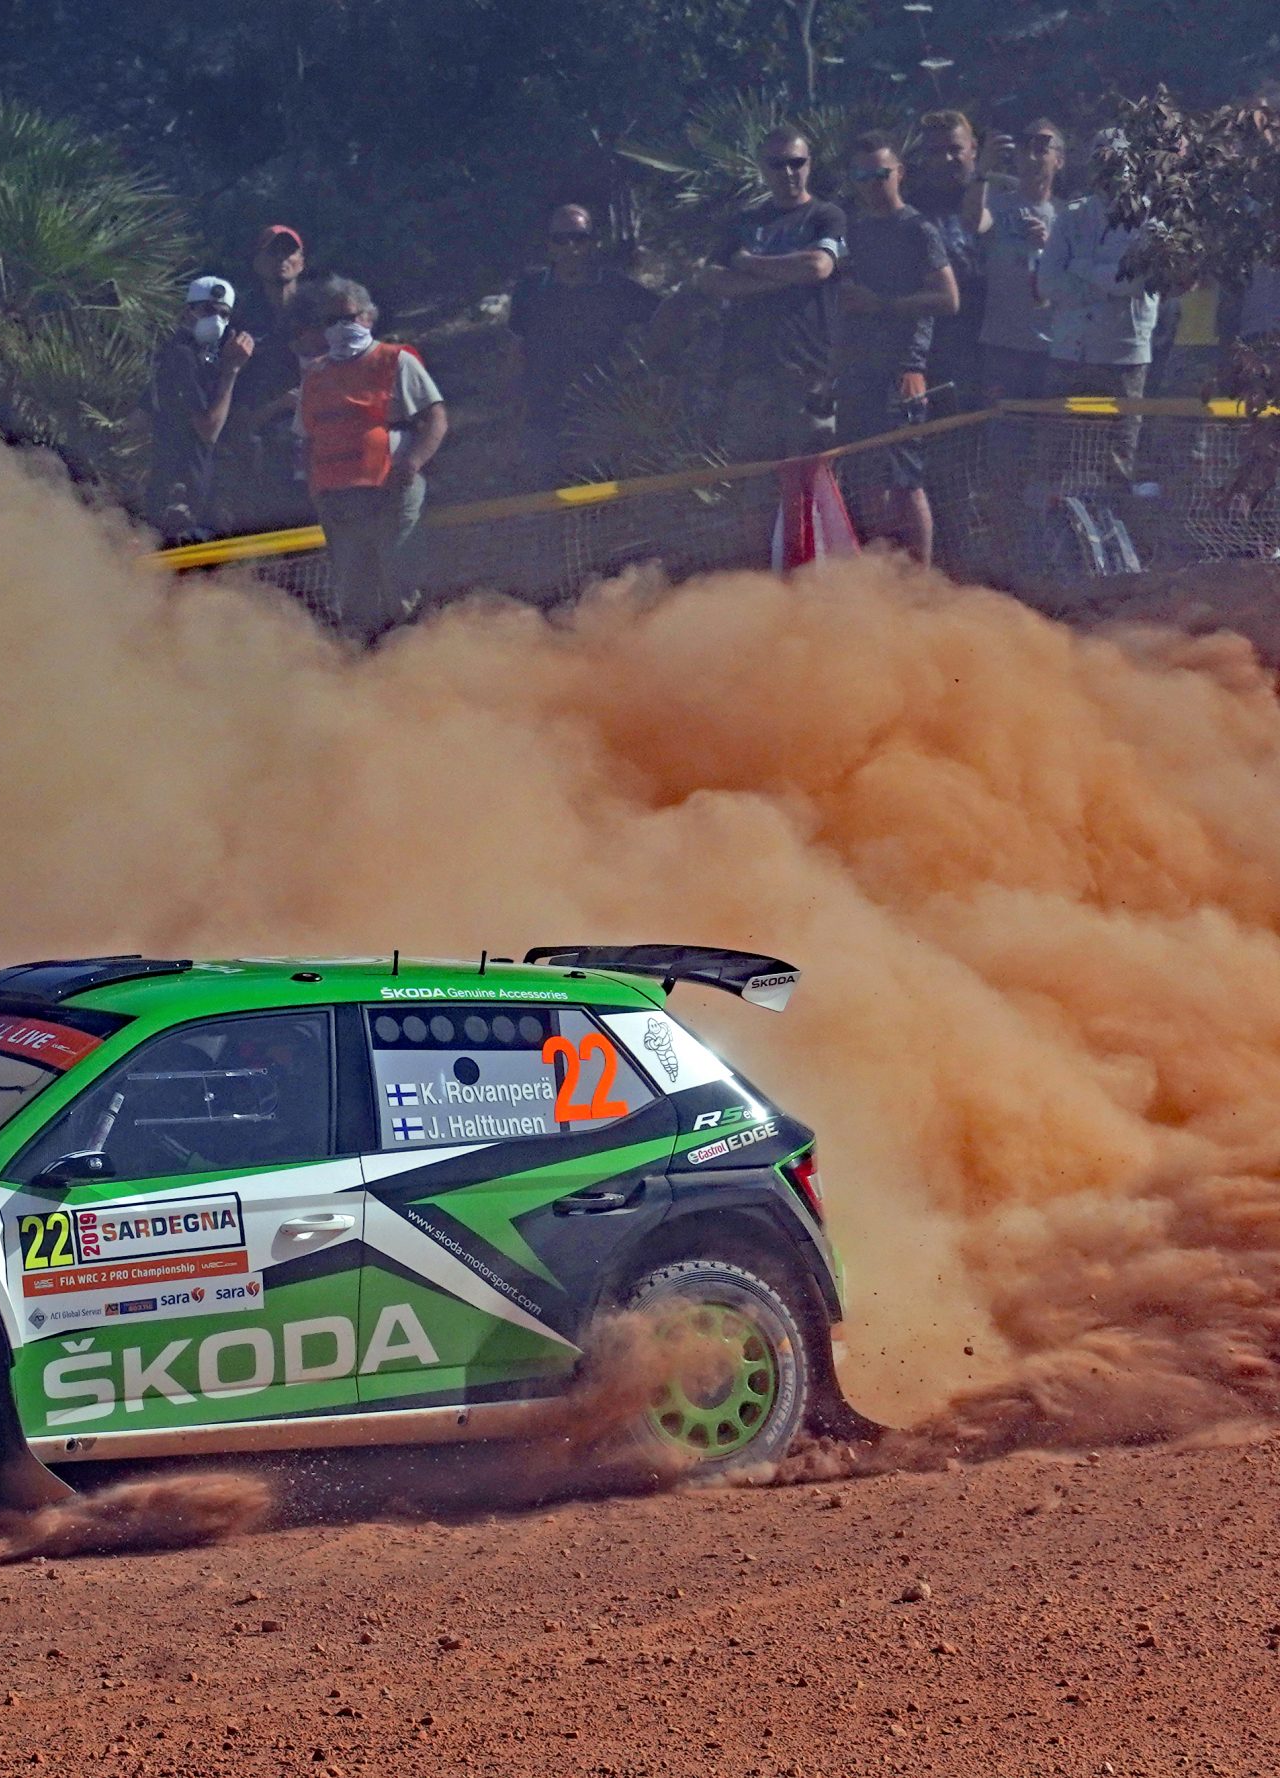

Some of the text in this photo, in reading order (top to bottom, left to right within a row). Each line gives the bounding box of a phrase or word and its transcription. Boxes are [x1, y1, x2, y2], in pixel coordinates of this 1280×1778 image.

[380, 987, 568, 1000] ŠKODA Genuine Accessories
[751, 975, 795, 989] ŠKODA
[8, 1027, 56, 1049] LIVE
[542, 1033, 629, 1122] 22
[420, 1077, 554, 1107] K. Rovanperä
[428, 1114, 546, 1139] J. Halttunen
[693, 1105, 744, 1131] R5
[698, 1122, 779, 1160] Castrol EDGE
[79, 1213, 101, 1257] 2019
[102, 1209, 237, 1242] SARDEGNA
[21, 1213, 74, 1270] 22
[60, 1263, 195, 1286] FIA WRC 2 PRO Championship
[407, 1209, 542, 1316] www.skoda-motorsport.com
[161, 1292, 190, 1306] sara
[215, 1286, 245, 1300] sara
[43, 1303, 440, 1427] ŠKODA
